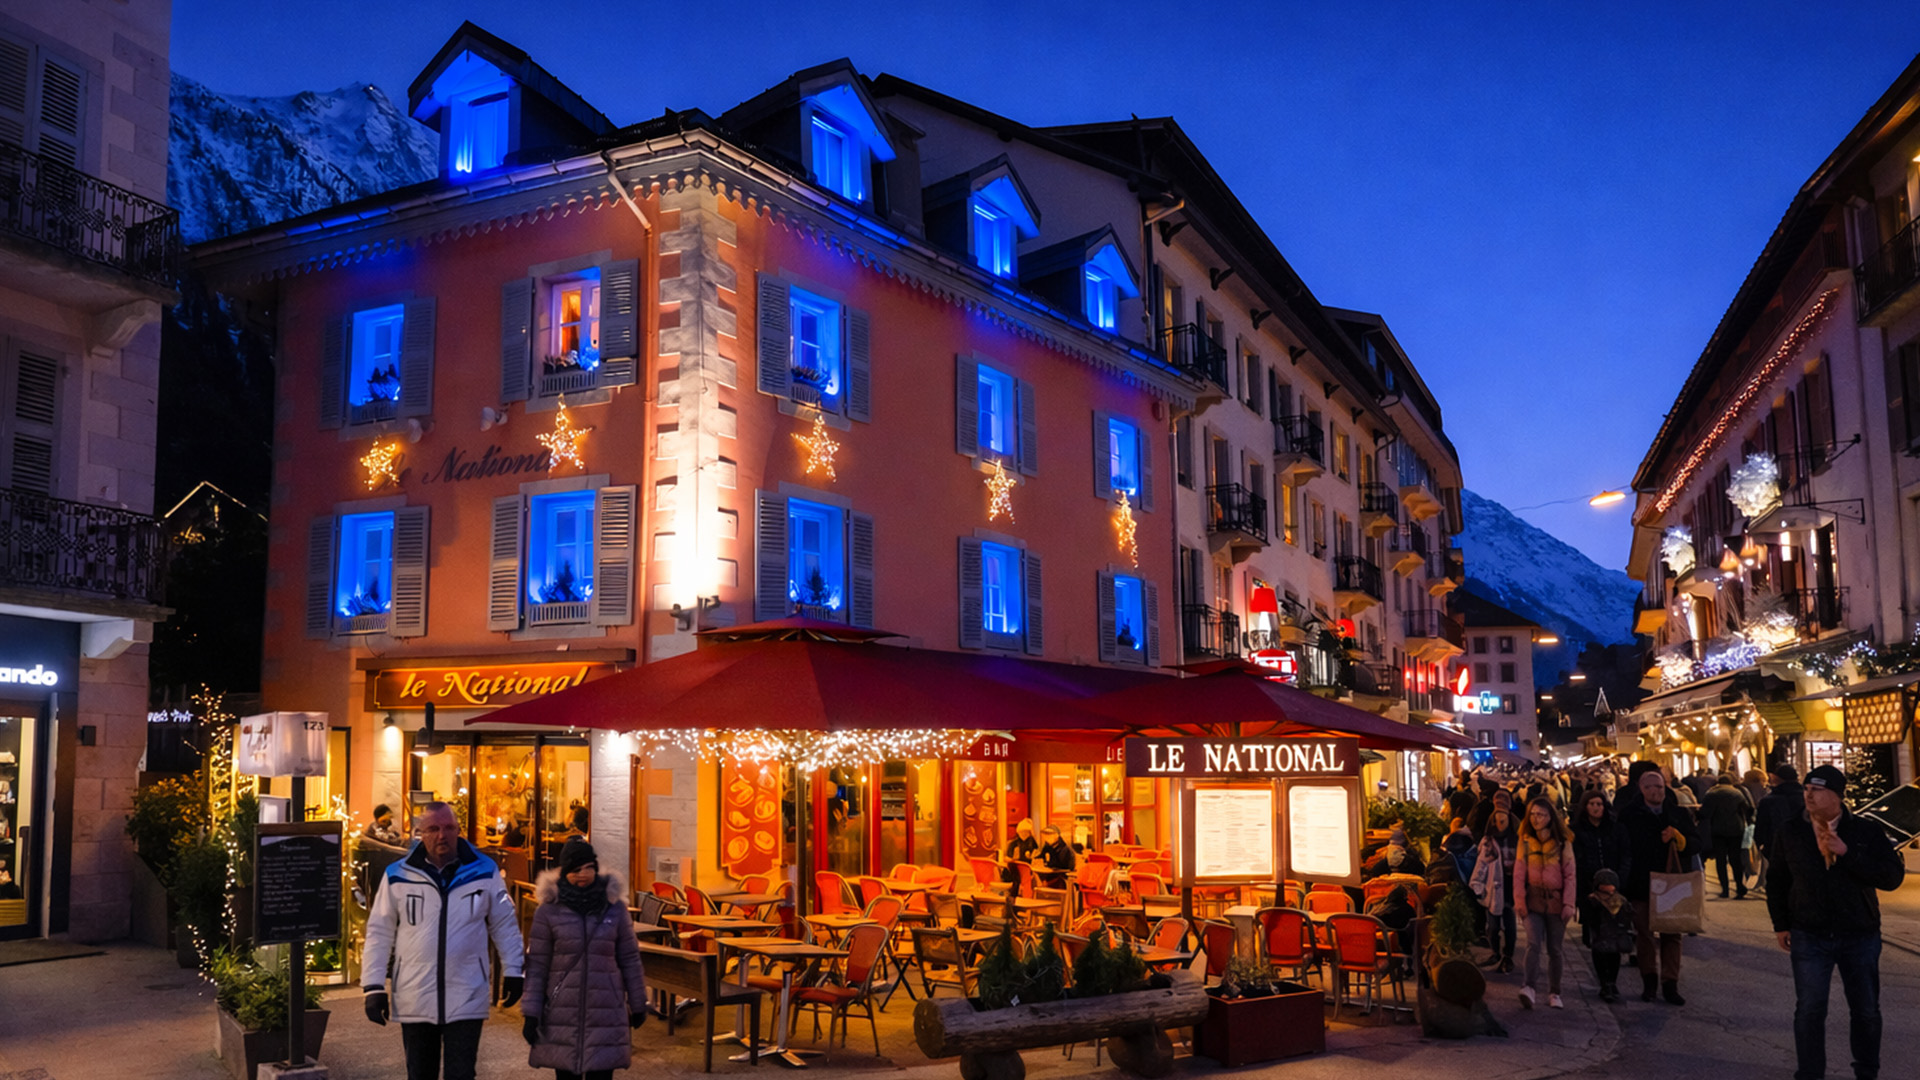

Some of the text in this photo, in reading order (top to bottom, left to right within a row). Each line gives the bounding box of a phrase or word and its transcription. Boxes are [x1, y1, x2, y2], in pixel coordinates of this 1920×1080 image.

[422, 445, 553, 485] Nationa
[400, 665, 590, 704] le National
[984, 742, 1009, 757] BAR
[1147, 743, 1344, 772] LE NATIONAL
